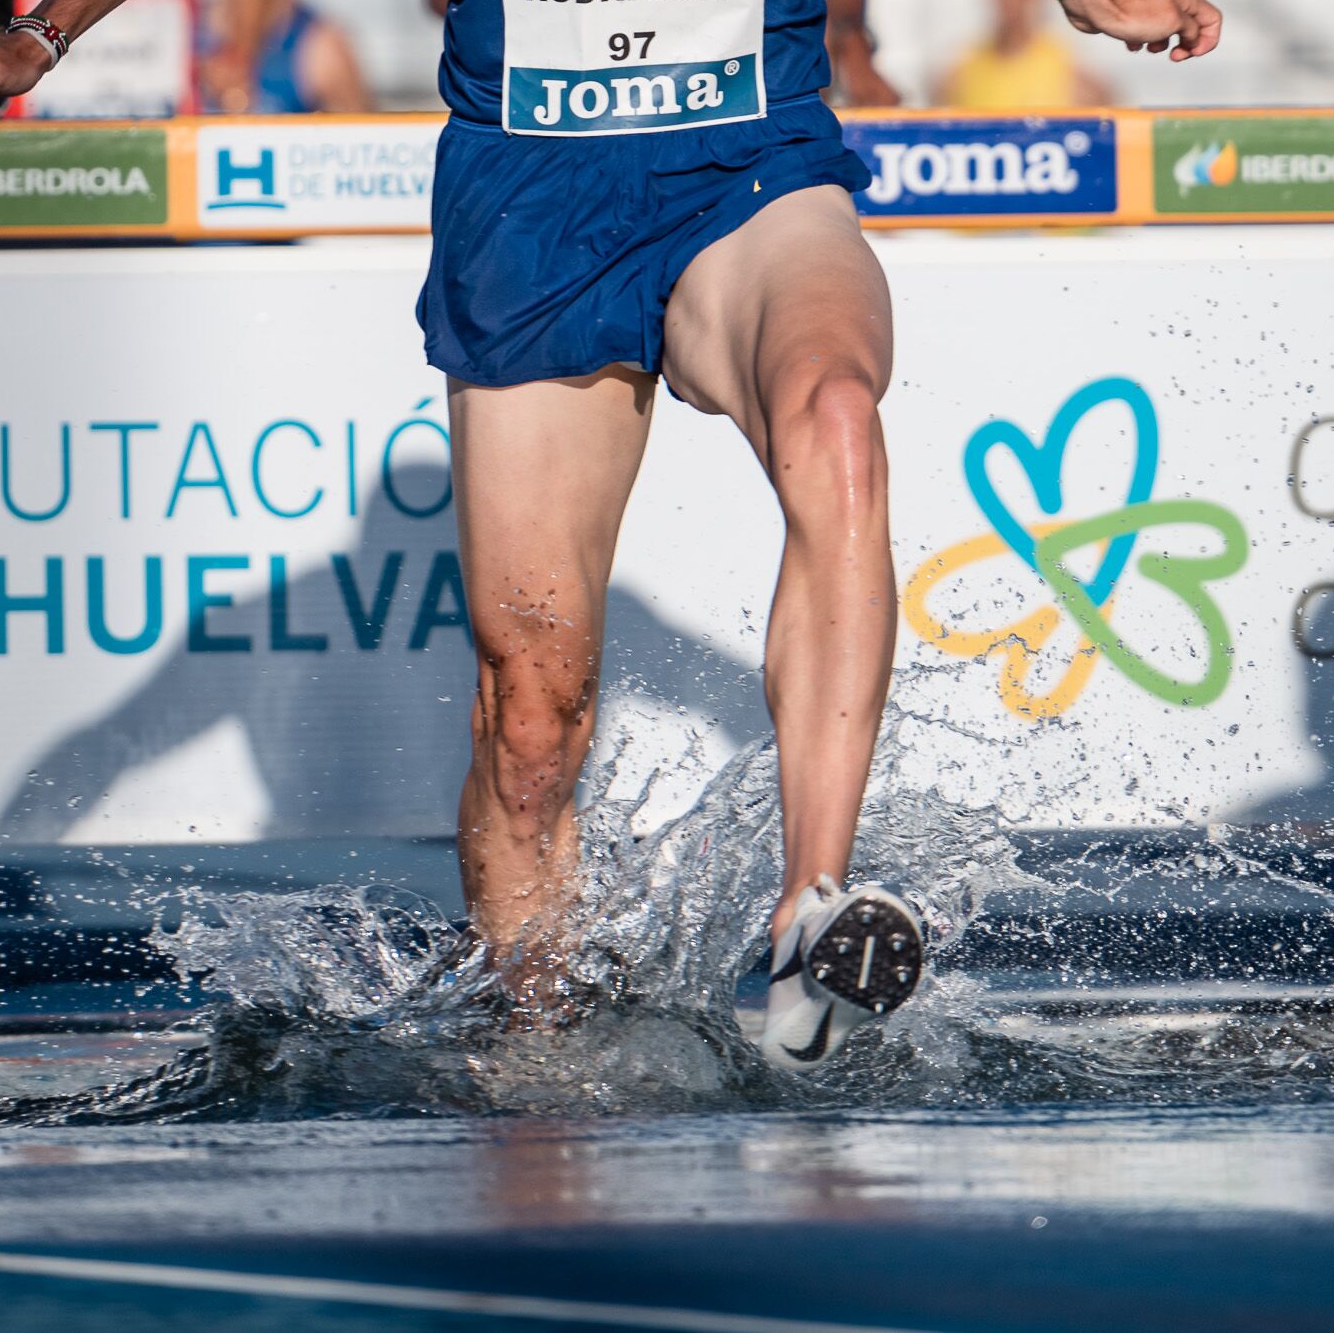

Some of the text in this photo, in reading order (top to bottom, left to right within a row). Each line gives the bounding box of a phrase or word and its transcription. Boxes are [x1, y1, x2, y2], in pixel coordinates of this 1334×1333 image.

[608, 31, 656, 61] 97
[288, 170, 430, 198] DE HUELV
